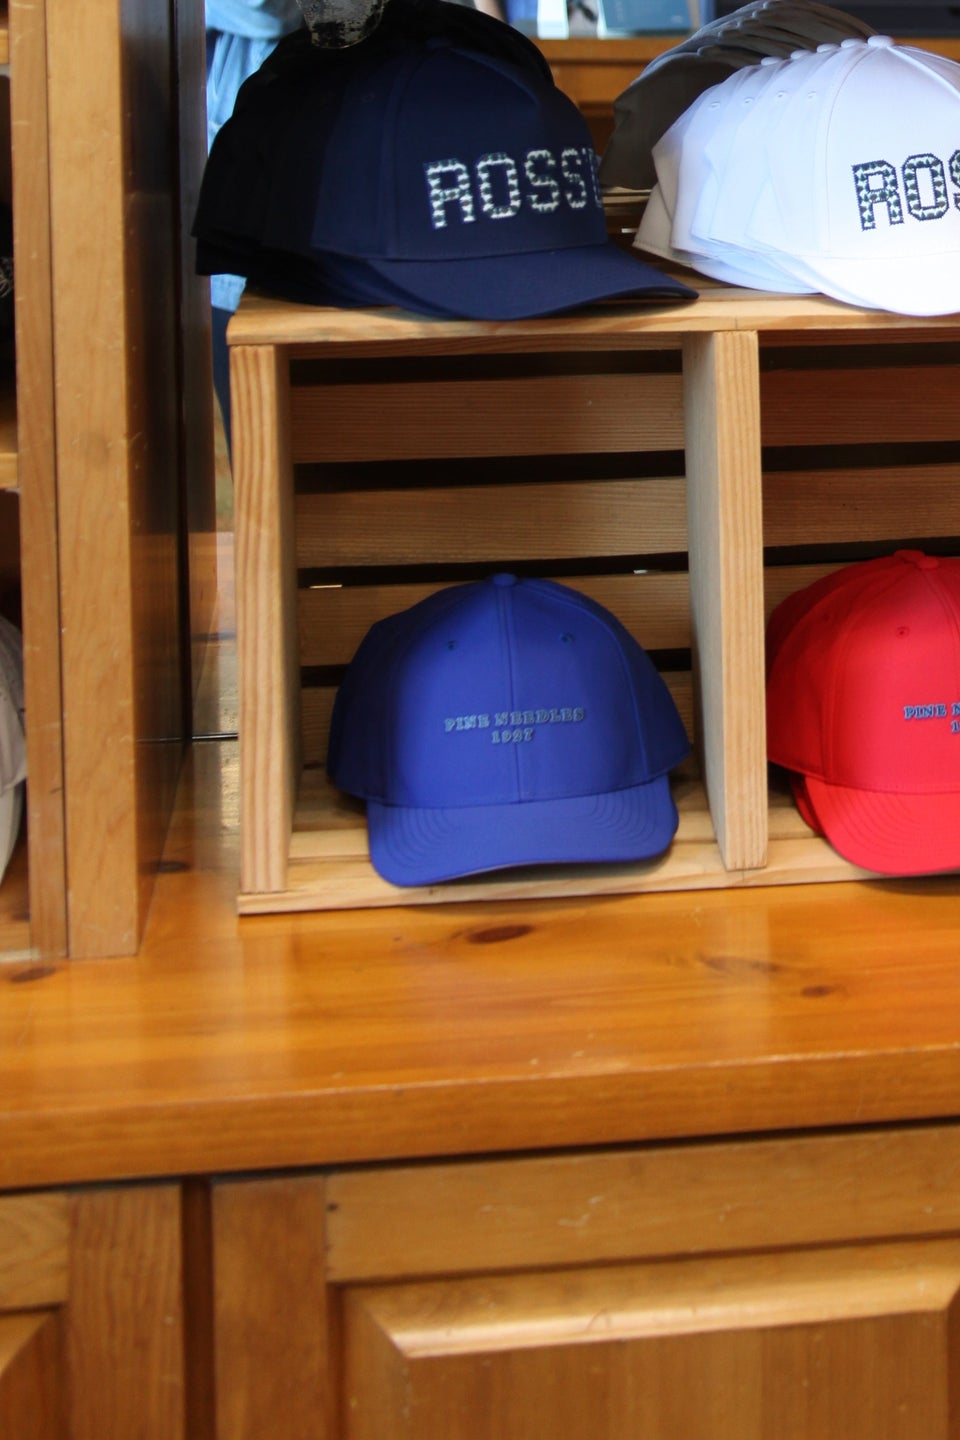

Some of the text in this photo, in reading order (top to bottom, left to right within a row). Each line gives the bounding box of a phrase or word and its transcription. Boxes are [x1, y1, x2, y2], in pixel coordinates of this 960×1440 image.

[444, 707, 585, 732] PINE NEEDLES
[903, 704, 946, 720] PINE
[491, 727, 534, 744] 1927
